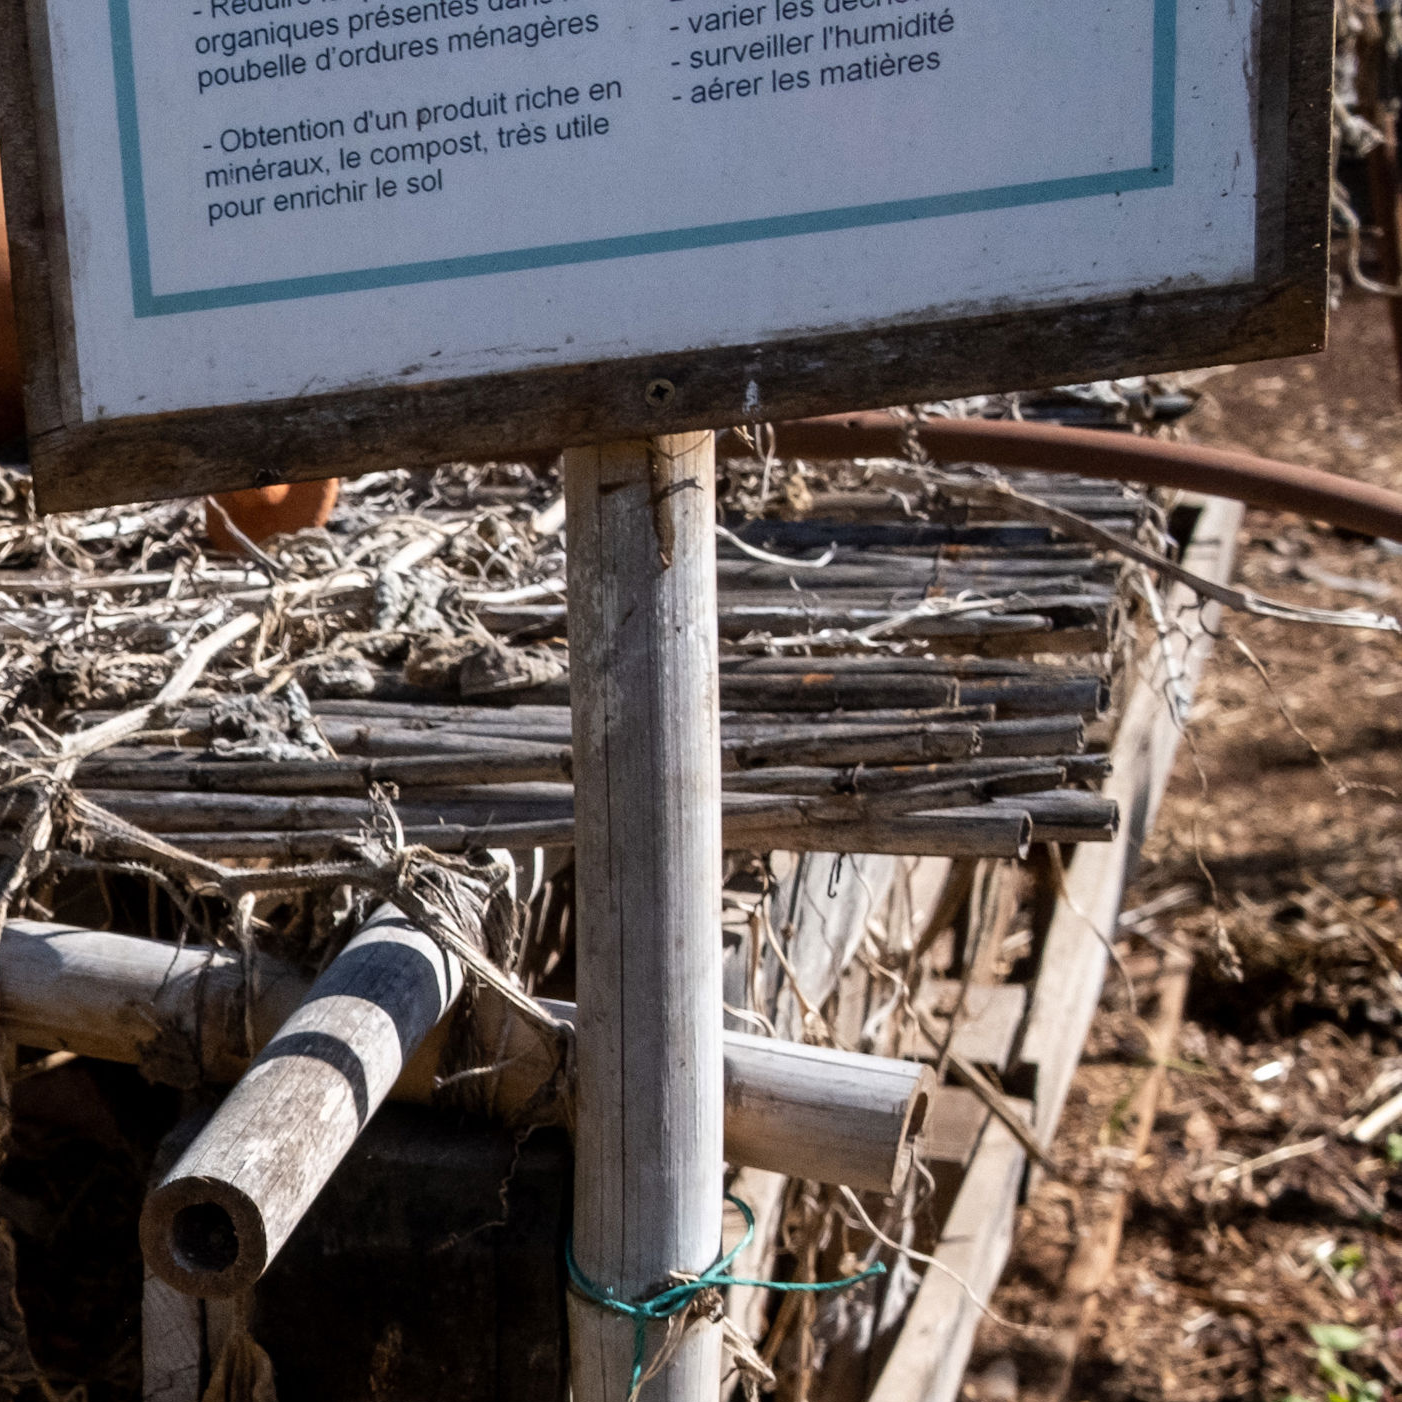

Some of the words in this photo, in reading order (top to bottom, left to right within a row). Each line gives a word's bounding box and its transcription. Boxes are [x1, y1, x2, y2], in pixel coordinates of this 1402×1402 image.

[196, 17, 339, 56] organiques
[348, 0, 478, 39] présentes
[688, 6, 766, 34] varier
[775, 0, 814, 22] les
[690, 34, 814, 69] surveiller
[823, 9, 955, 50] l'humidité
[198, 53, 306, 93] poubelle
[448, 13, 599, 52] ménagères
[691, 76, 763, 104] aérer
[772, 69, 810, 93] les
[820, 51, 941, 86] matières
[220, 117, 345, 154] Obtention
[354, 108, 407, 134] d'un
[416, 92, 508, 131] produit
[516, 83, 580, 113] riche
[589, 77, 622, 101] en
[206, 148, 330, 188] minéraux,
[340, 148, 361, 172] le
[370, 129, 488, 166] compost,
[498, 122, 547, 149] très
[556, 113, 609, 142] utile
[208, 197, 265, 226] pour
[274, 178, 369, 213] enrichir
[376, 176, 397, 199] le
[407, 169, 444, 194] sol
